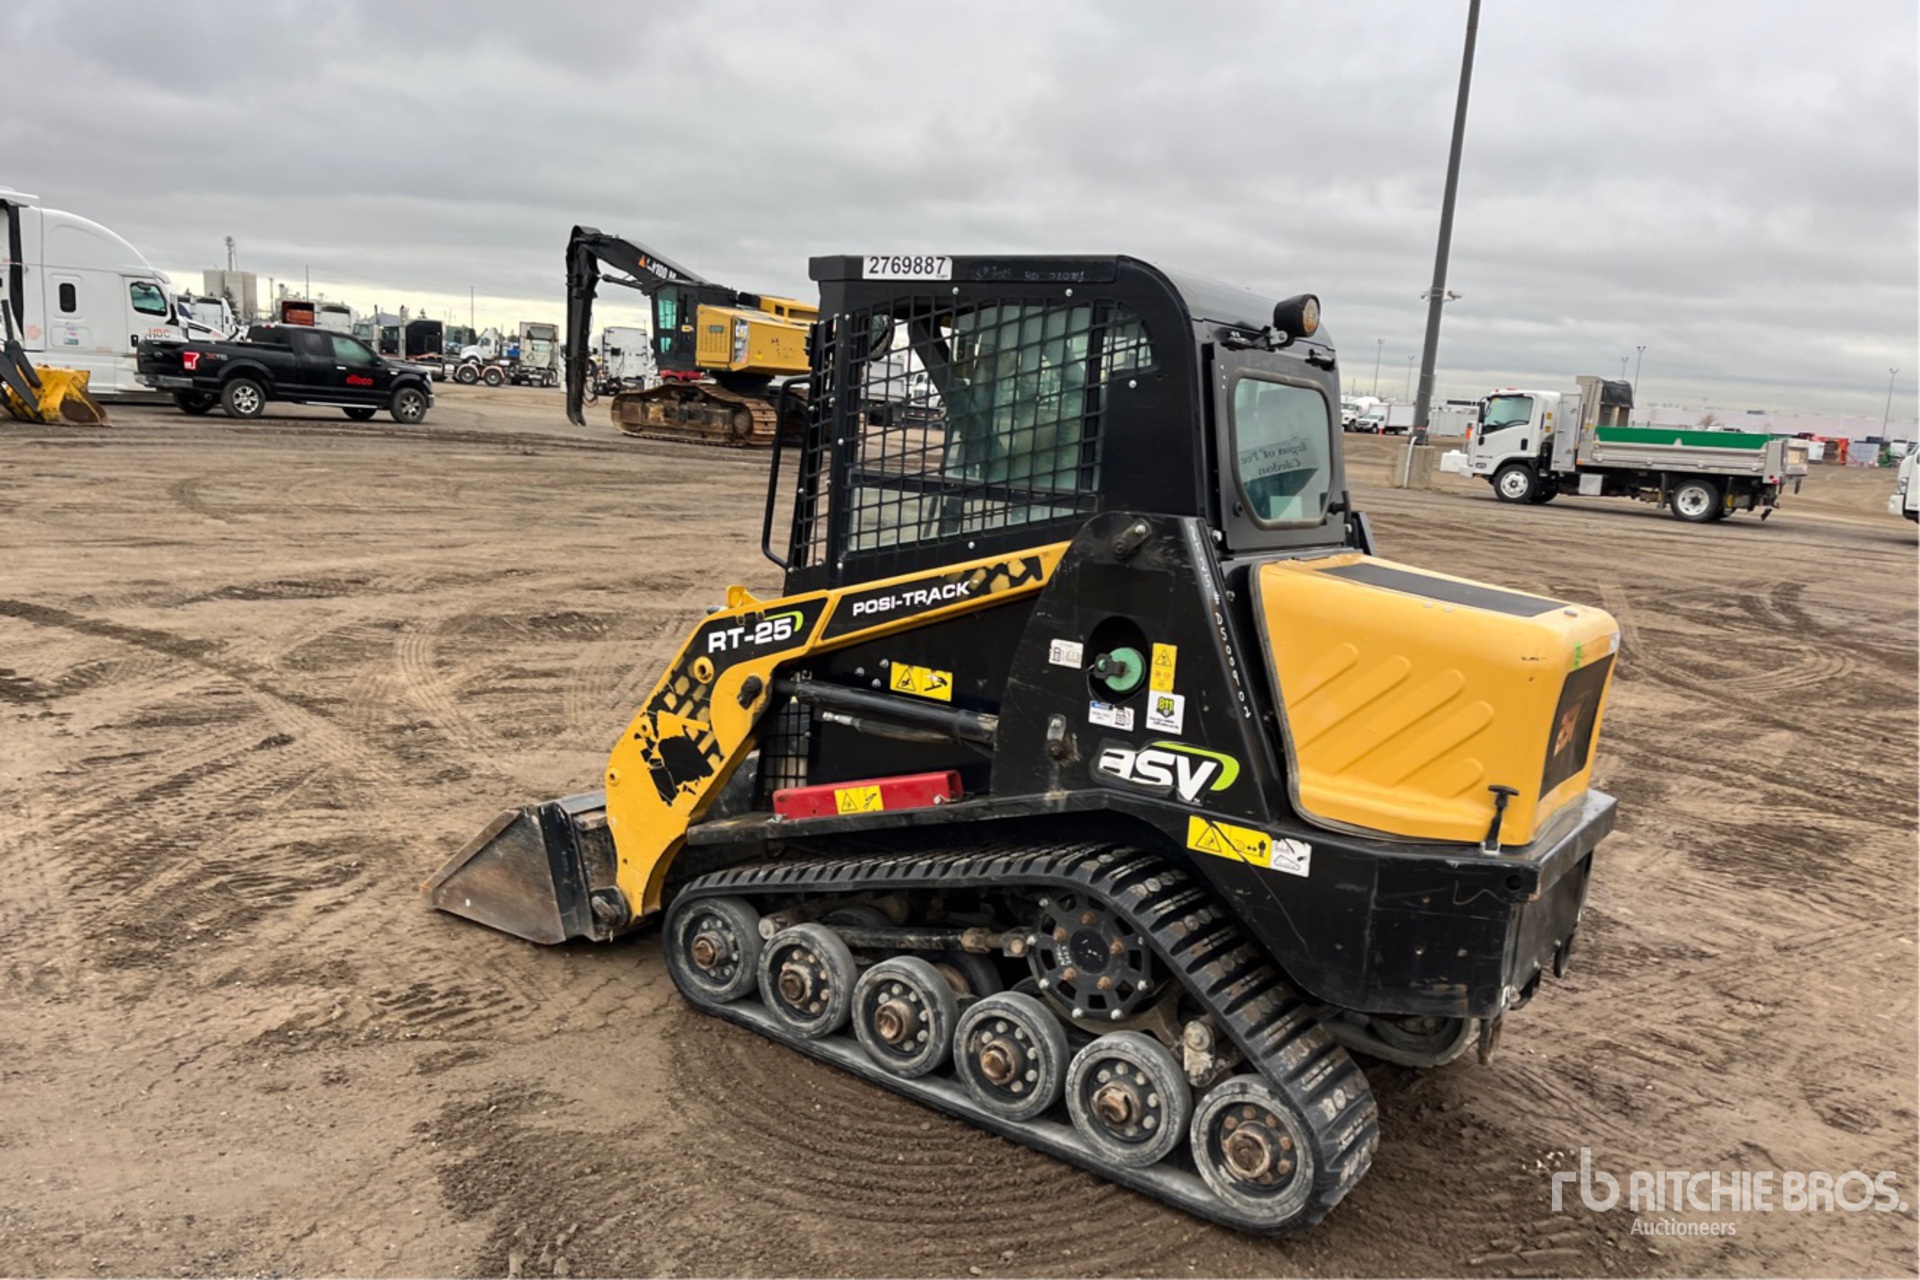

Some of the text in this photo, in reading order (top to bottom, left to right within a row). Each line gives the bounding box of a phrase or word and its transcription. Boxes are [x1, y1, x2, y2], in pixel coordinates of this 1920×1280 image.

[868, 255, 947, 275] 2769887
[852, 581, 971, 617] POSI-TRACK
[707, 617, 792, 653] RT-25
[1158, 697, 1174, 711] 811
